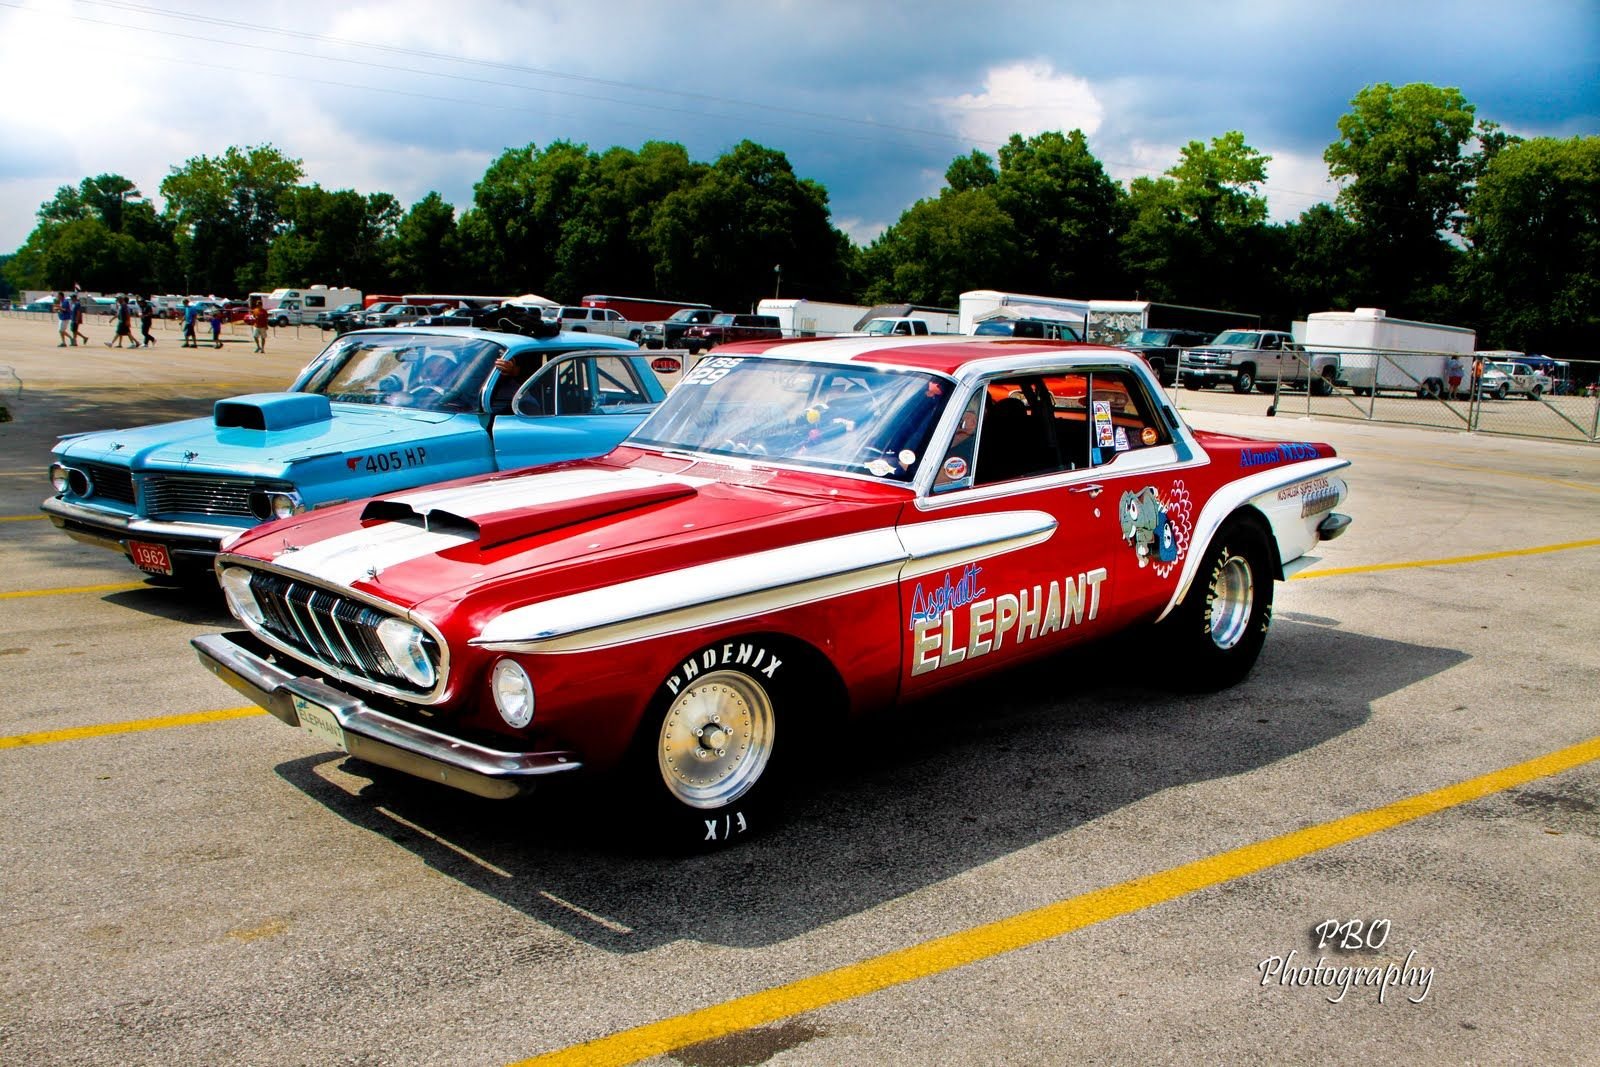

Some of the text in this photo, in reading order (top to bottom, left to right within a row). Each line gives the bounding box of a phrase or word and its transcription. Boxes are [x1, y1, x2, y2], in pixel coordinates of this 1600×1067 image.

[366, 451, 402, 473] 405
[1240, 447, 1280, 467] Almost
[1299, 480, 1312, 496] SUPER
[137, 548, 166, 566] 1962
[909, 563, 986, 630] Asphalt
[1204, 546, 1230, 634] PHOENIX
[911, 567, 1107, 677] ELEPHANT
[666, 643, 783, 696] PHOENIX
[300, 709, 342, 738] ELEPHANT
[704, 811, 748, 841] F/X
